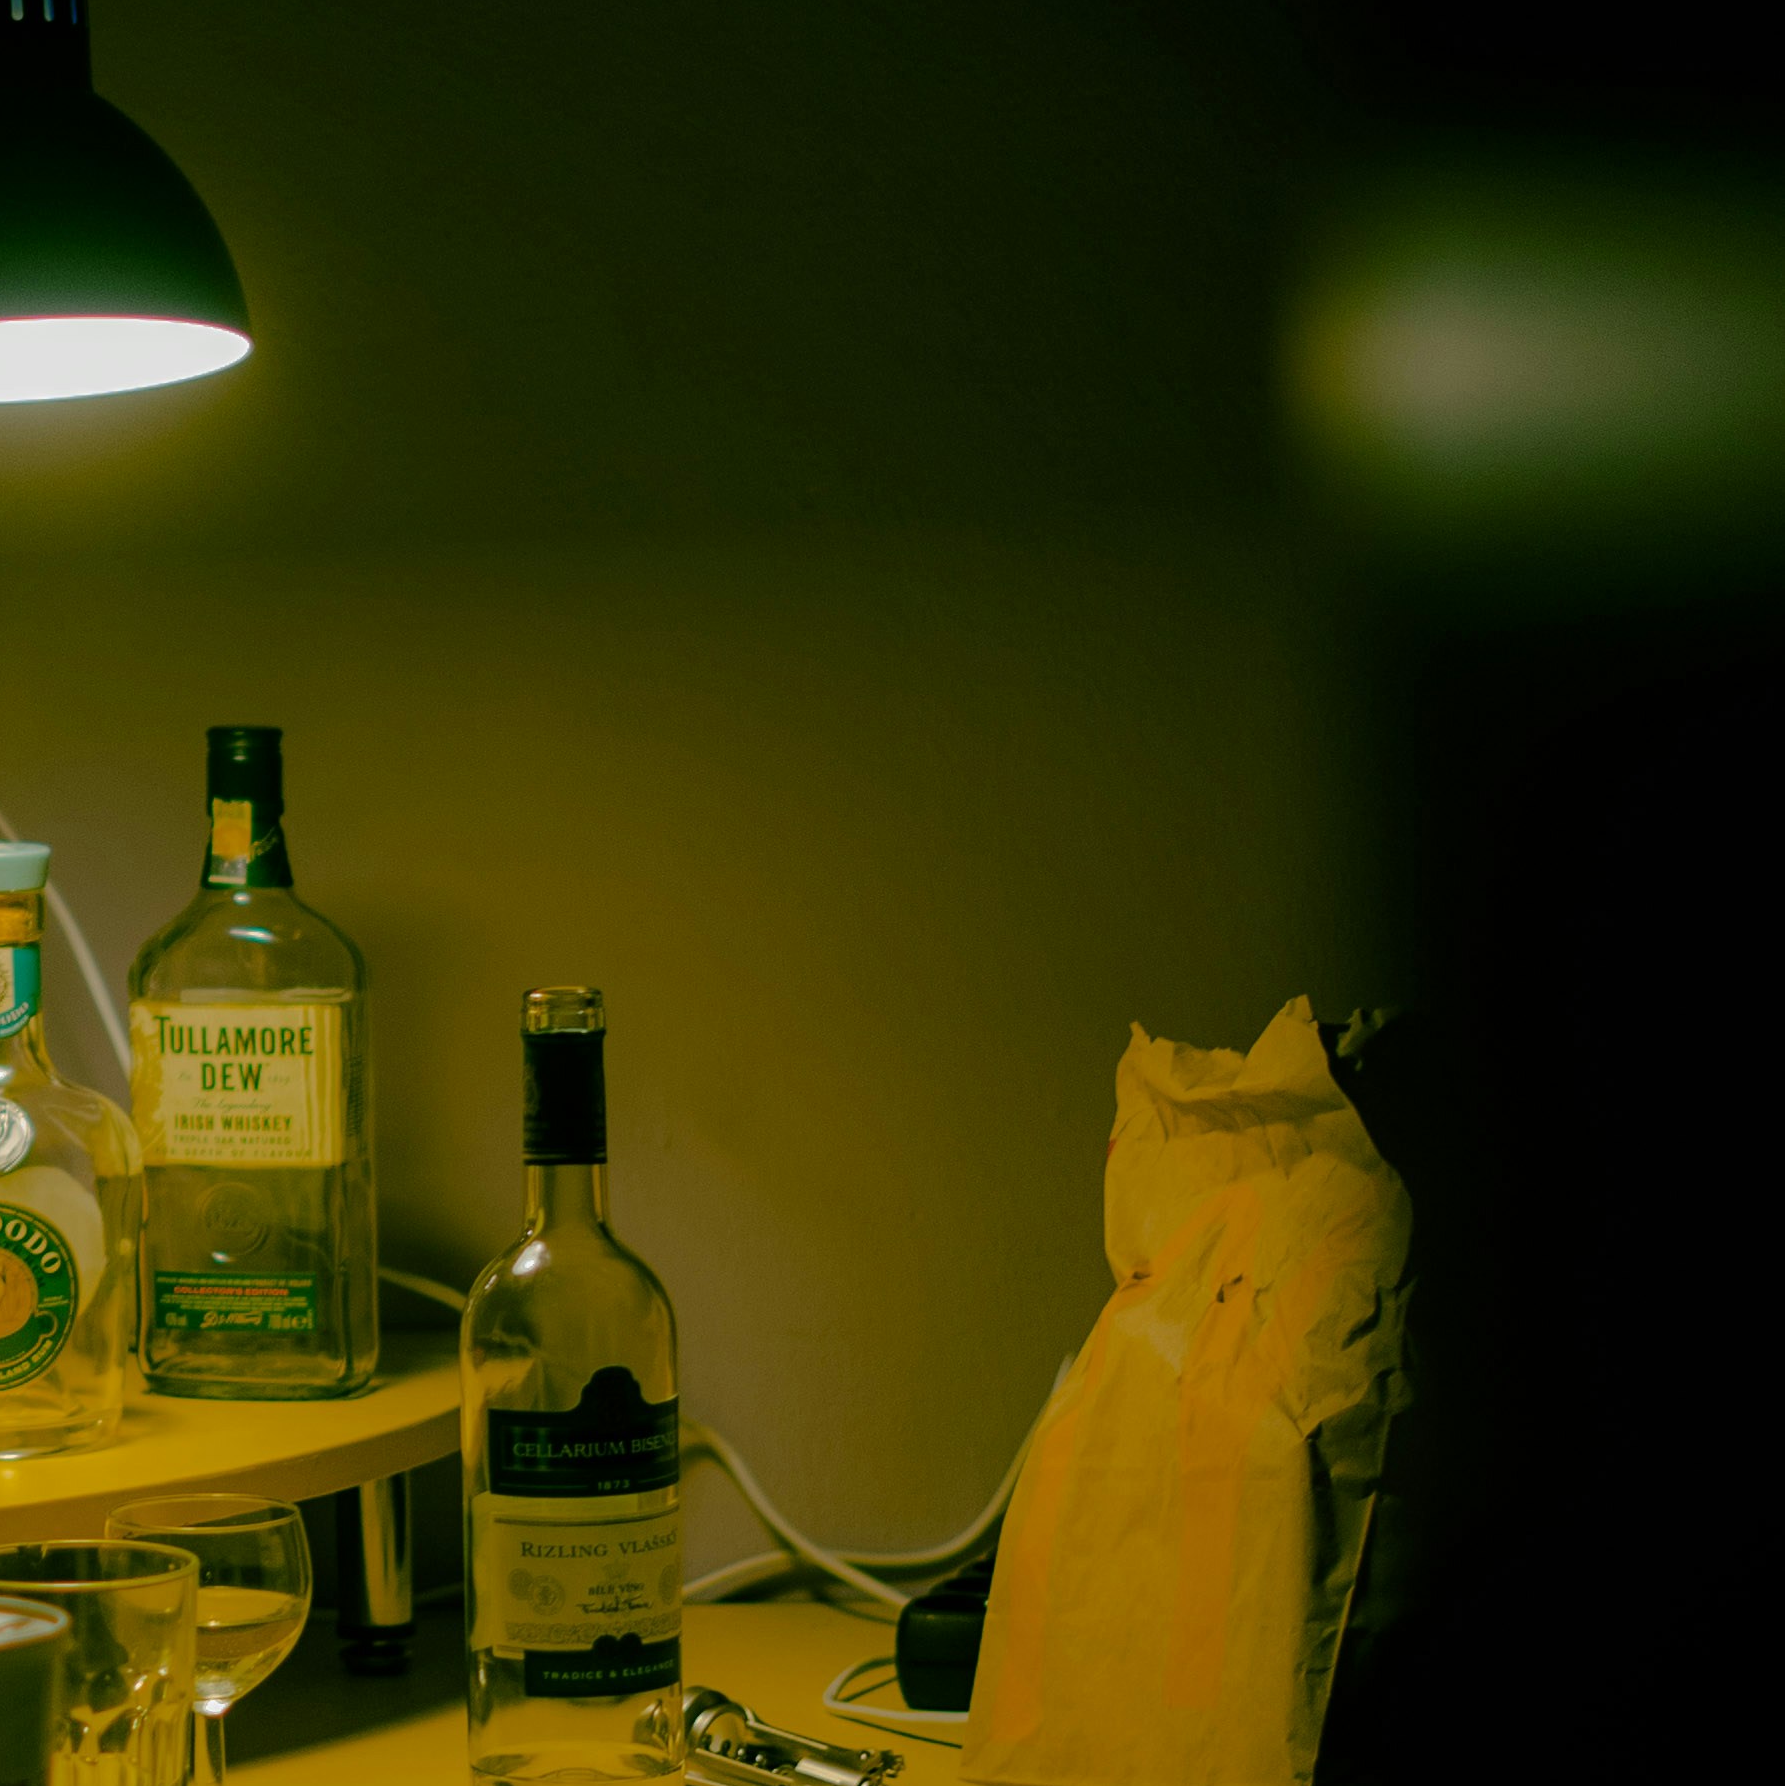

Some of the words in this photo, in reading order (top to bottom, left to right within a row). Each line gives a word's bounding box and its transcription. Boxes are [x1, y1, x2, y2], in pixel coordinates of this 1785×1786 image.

[153, 1014, 315, 1056] TULLAMORE
[201, 1062, 263, 1091] DEW
[174, 1113, 215, 1131] IRISH
[221, 1114, 294, 1132] WHISKEY
[244, 1287, 290, 1297] EDITION
[512, 1440, 628, 1460] CELLARIUM
[597, 1479, 631, 1492] 1873
[520, 1540, 608, 1559] RIZLING
[543, 1670, 604, 1682] TRADICE
